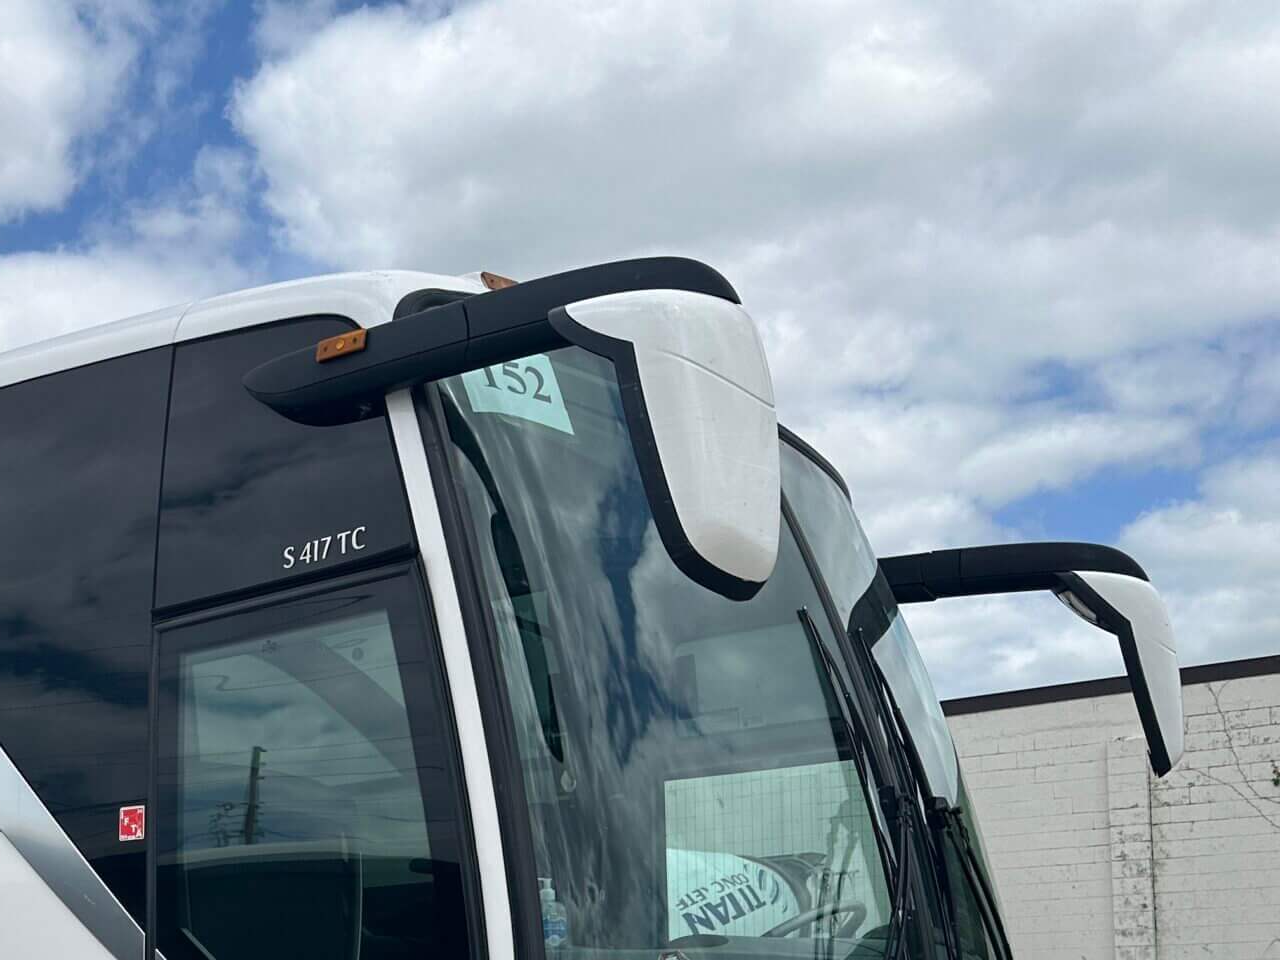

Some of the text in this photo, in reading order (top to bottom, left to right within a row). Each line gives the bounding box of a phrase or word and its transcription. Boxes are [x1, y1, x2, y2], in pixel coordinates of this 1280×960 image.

[484, 362, 552, 404] 152
[282, 526, 366, 569] S 417 TC
[681, 884, 766, 935] TITAN
